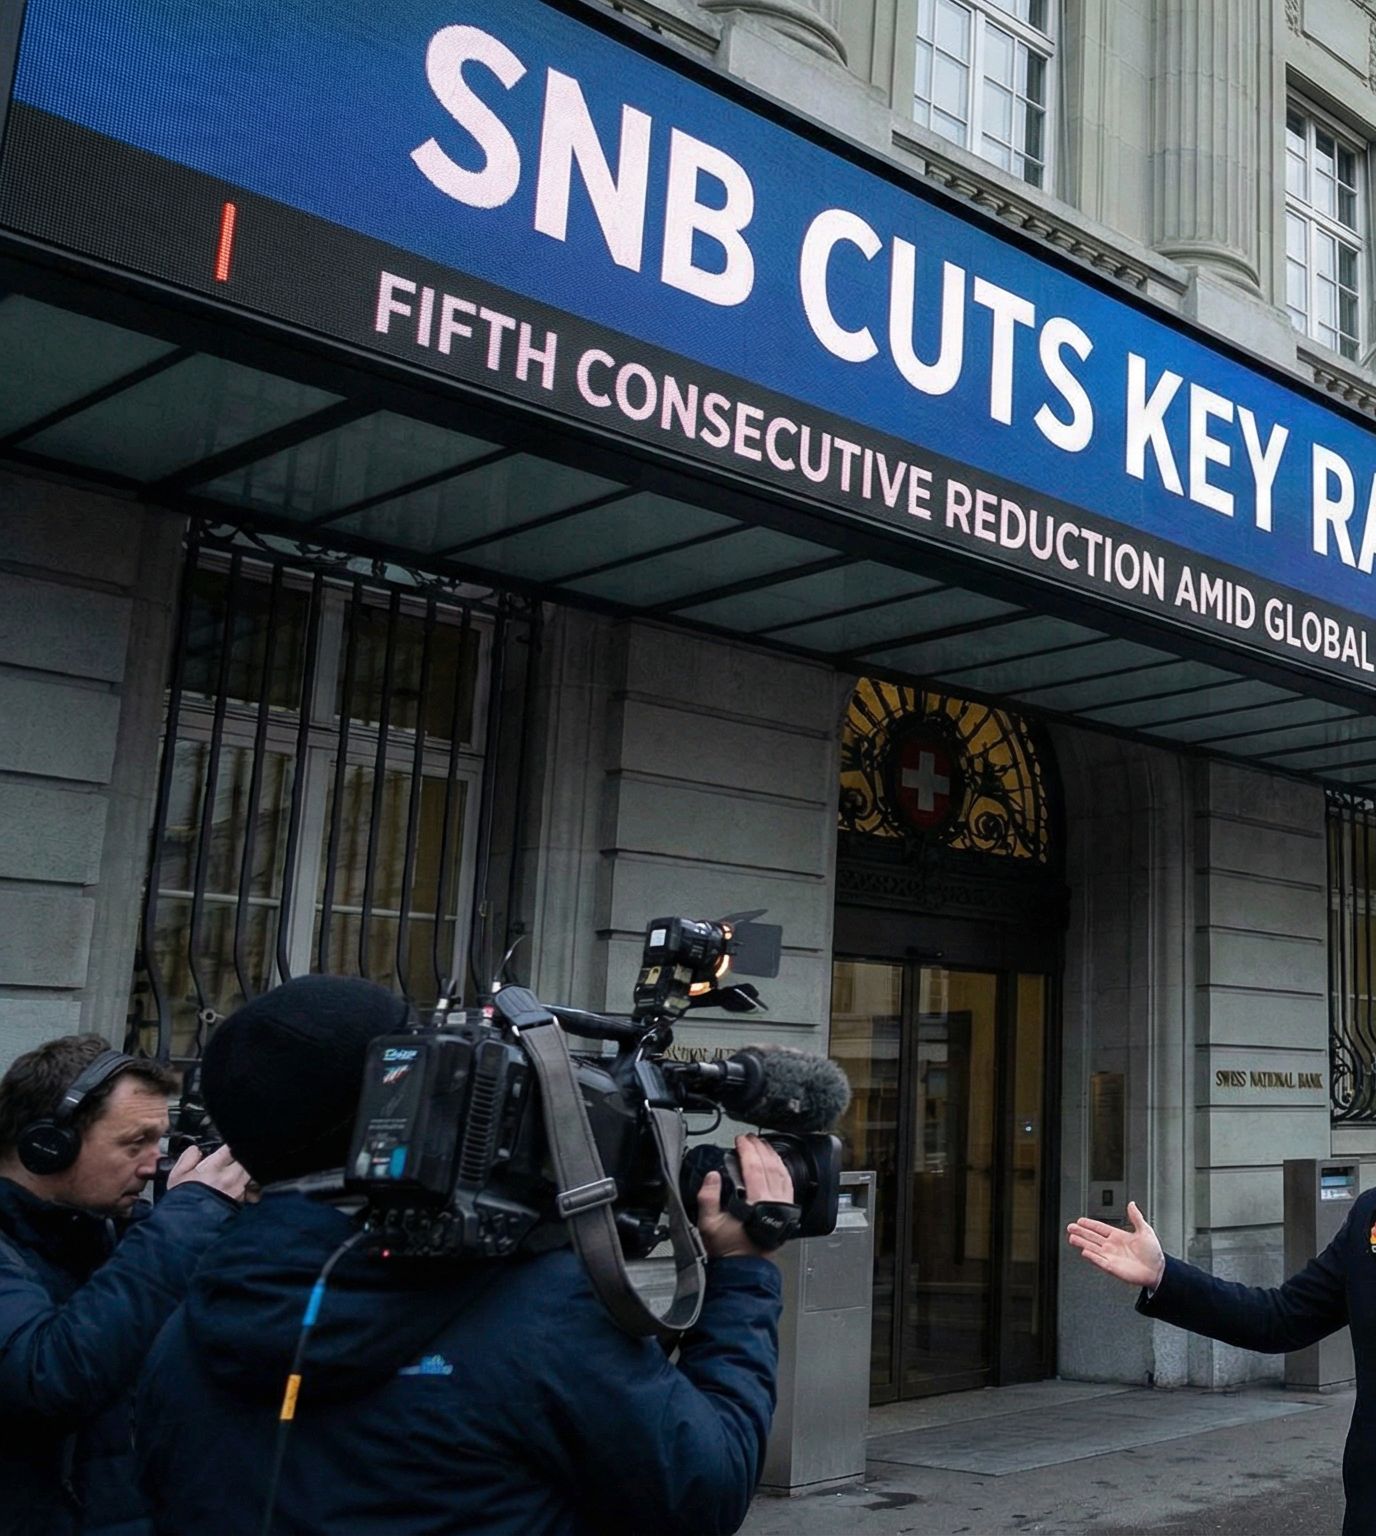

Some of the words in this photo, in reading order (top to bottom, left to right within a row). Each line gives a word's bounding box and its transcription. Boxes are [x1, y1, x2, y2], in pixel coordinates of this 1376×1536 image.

[374, 270, 558, 391] FIFTH
[576, 348, 933, 521] CONSECUTIVE
[945, 478, 1165, 601] REDUCTION
[1175, 565, 1256, 630] AMID
[1264, 597, 1375, 673] GLOBAL
[410, 25, 755, 307] SNB
[800, 208, 1094, 453] CUTS
[1126, 352, 1290, 533] KEY
